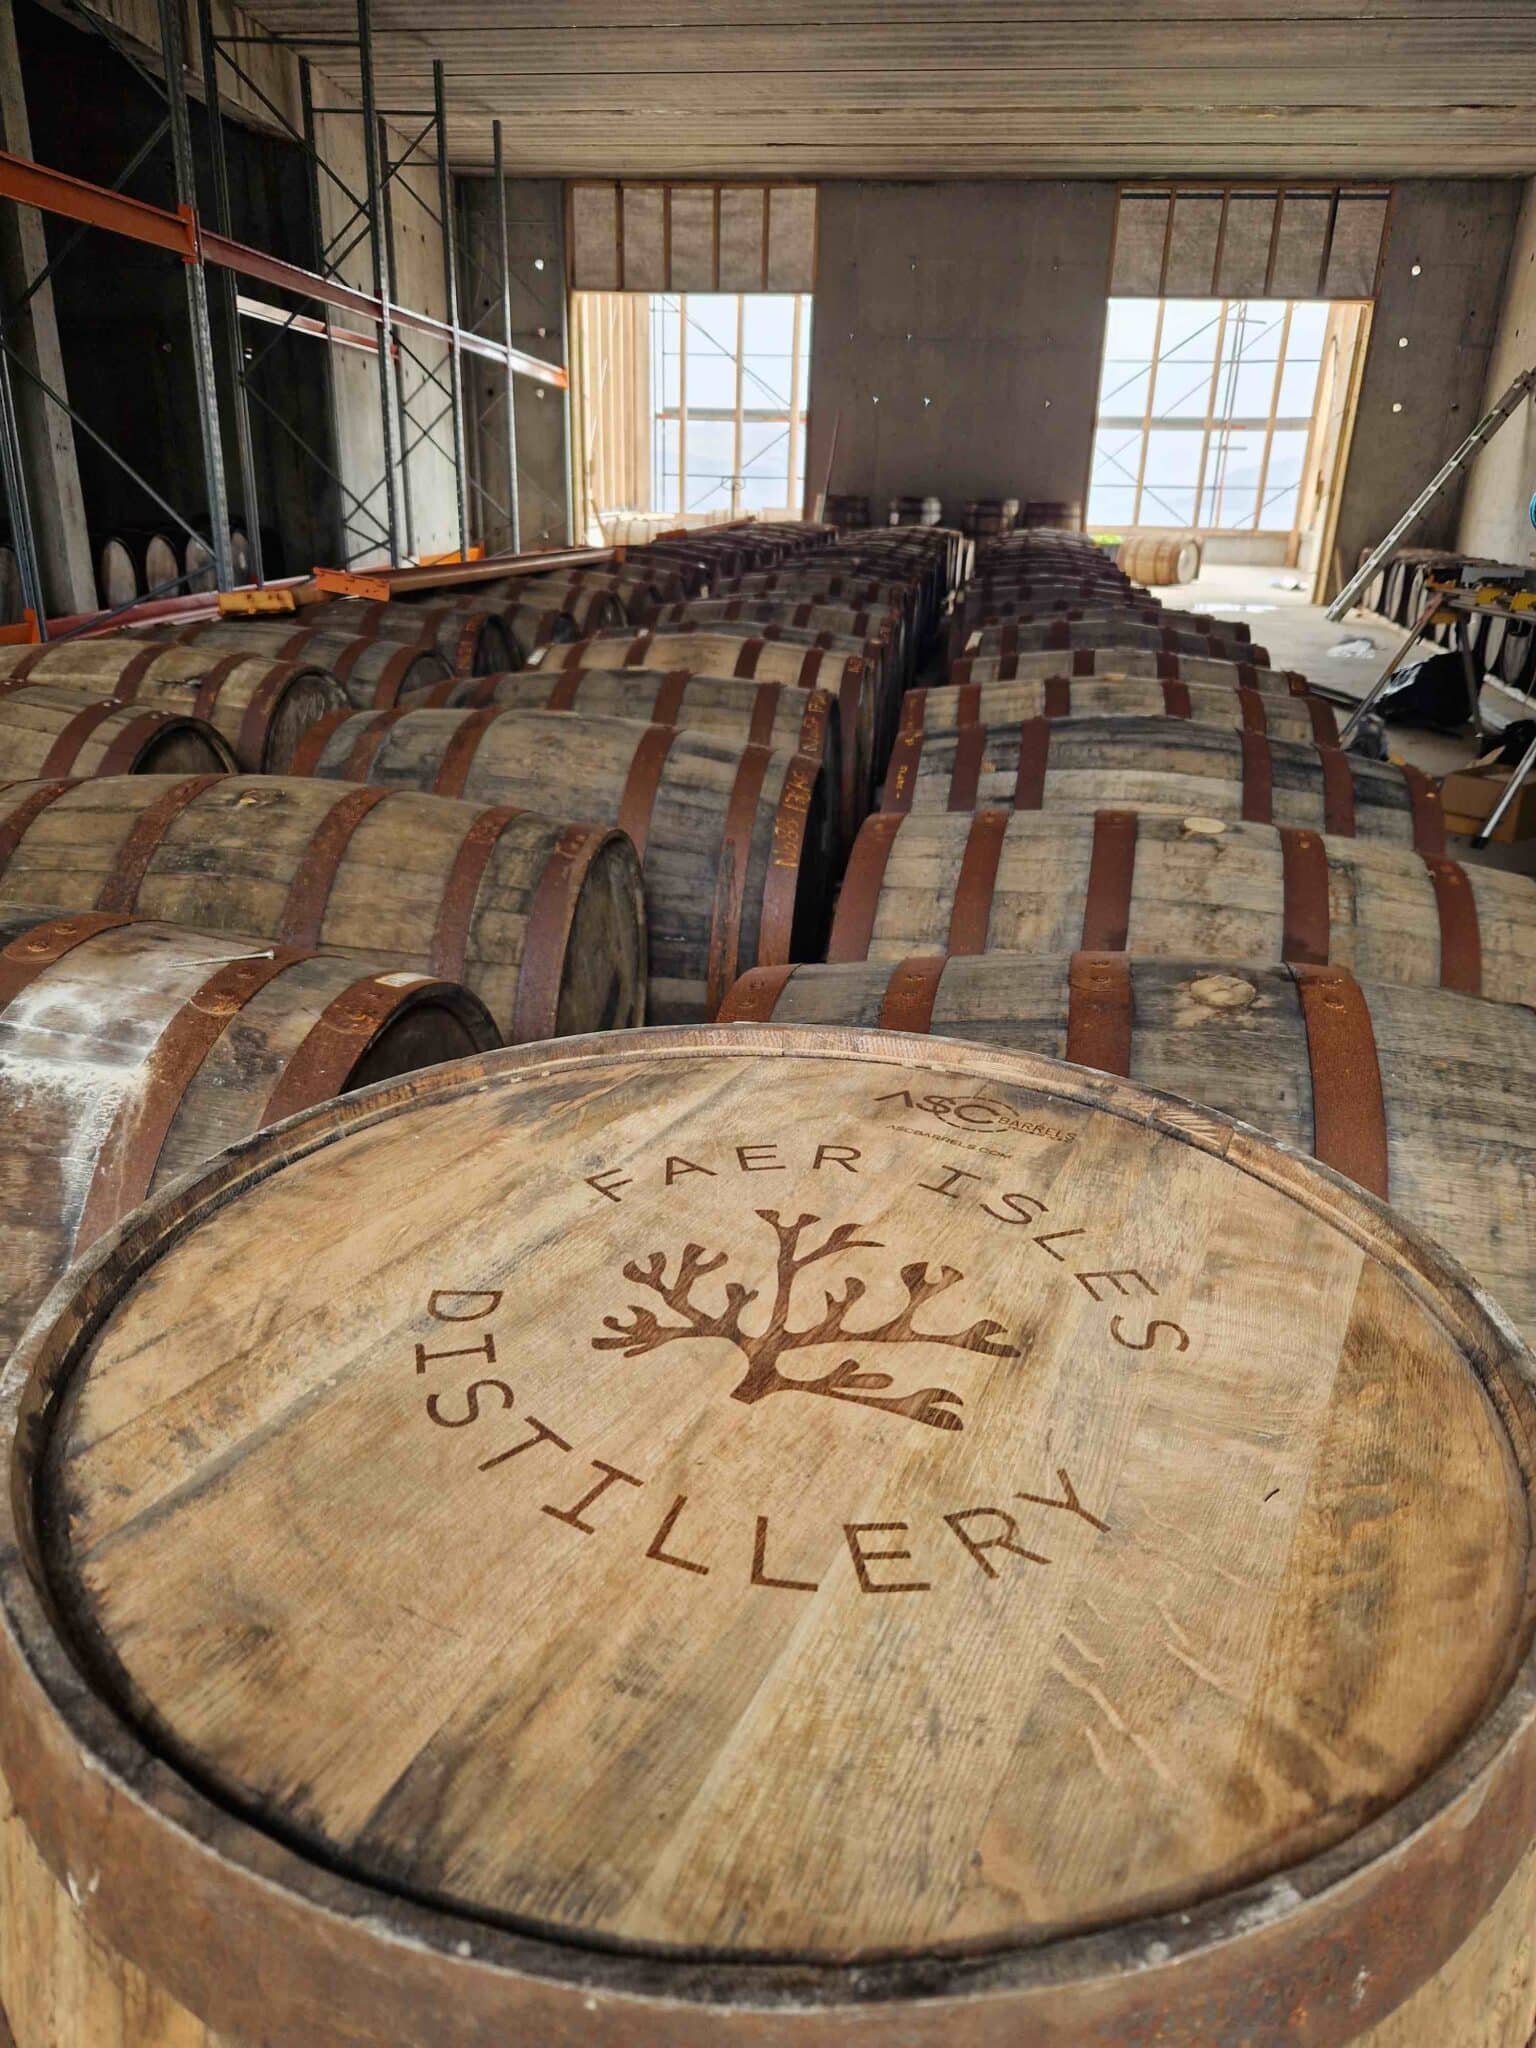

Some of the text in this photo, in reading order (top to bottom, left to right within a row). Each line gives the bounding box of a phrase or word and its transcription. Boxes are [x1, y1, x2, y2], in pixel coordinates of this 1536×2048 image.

[998, 1116, 1078, 1142] BARRELS
[583, 1143, 1191, 1353] FAER ISLES
[414, 1289, 1112, 1594] DISTILLERY
